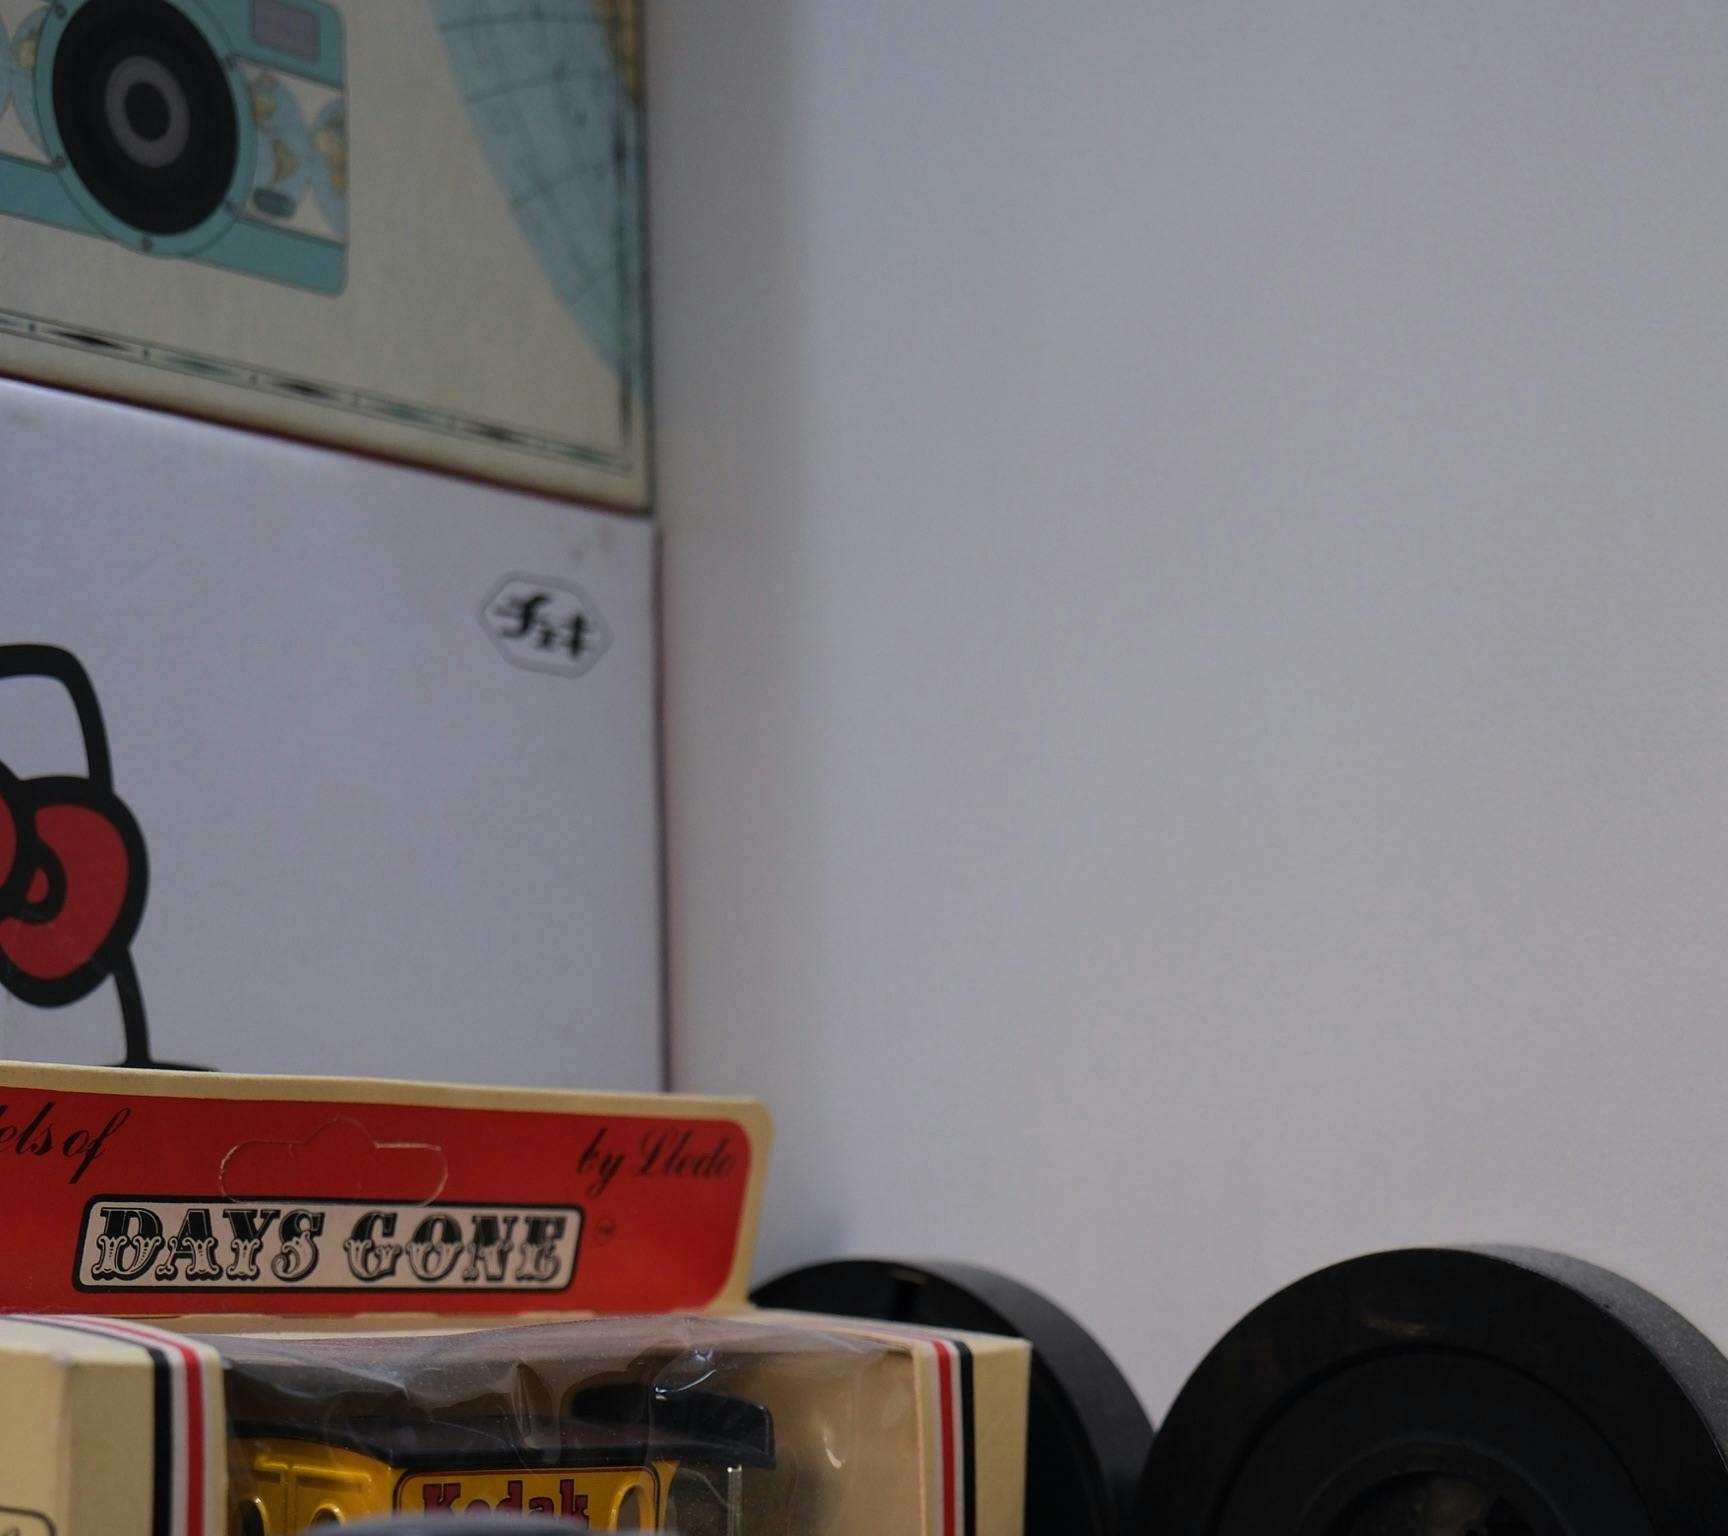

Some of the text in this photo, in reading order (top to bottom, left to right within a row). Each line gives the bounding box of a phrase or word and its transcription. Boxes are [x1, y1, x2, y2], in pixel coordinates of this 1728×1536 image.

[0, 1101, 131, 1184] els of
[576, 1127, 625, 1198] by
[92, 1206, 568, 1283] DAYS GONE
